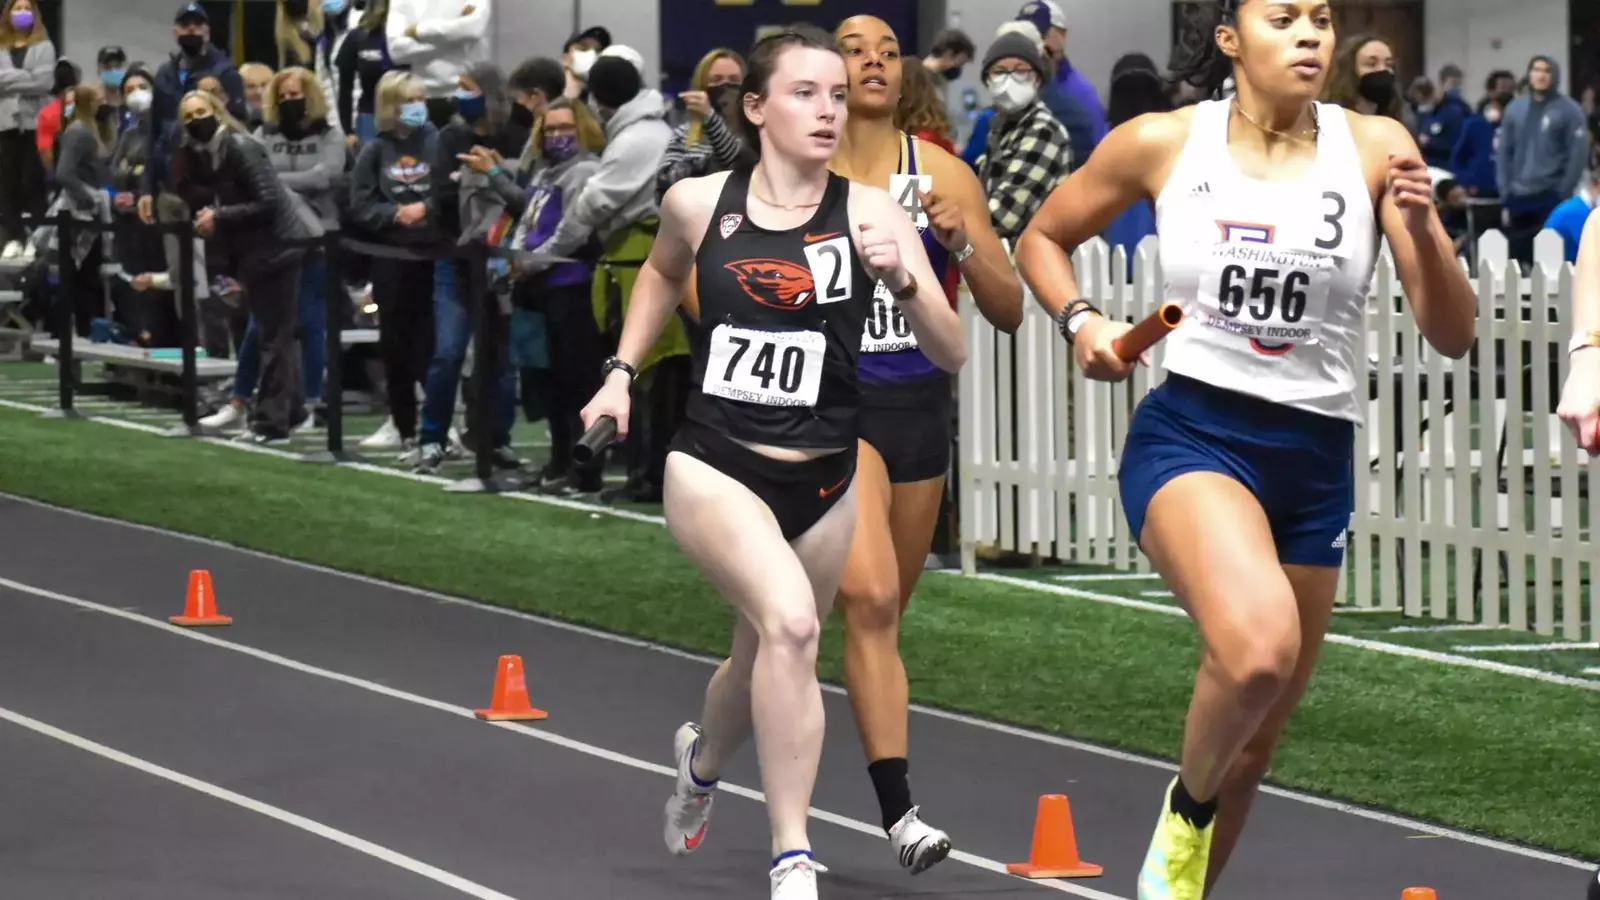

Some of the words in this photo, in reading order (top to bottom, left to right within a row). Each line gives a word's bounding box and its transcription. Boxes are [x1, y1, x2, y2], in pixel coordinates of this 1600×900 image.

[897, 178, 922, 223] 4
[1314, 190, 1346, 250] 3
[817, 244, 846, 299] 2
[1218, 264, 1310, 323] 656
[1266, 326, 1311, 338] INDOOR
[722, 335, 805, 394] 740
[712, 384, 763, 403] DEMPSEY
[766, 394, 808, 407] INDOOR
